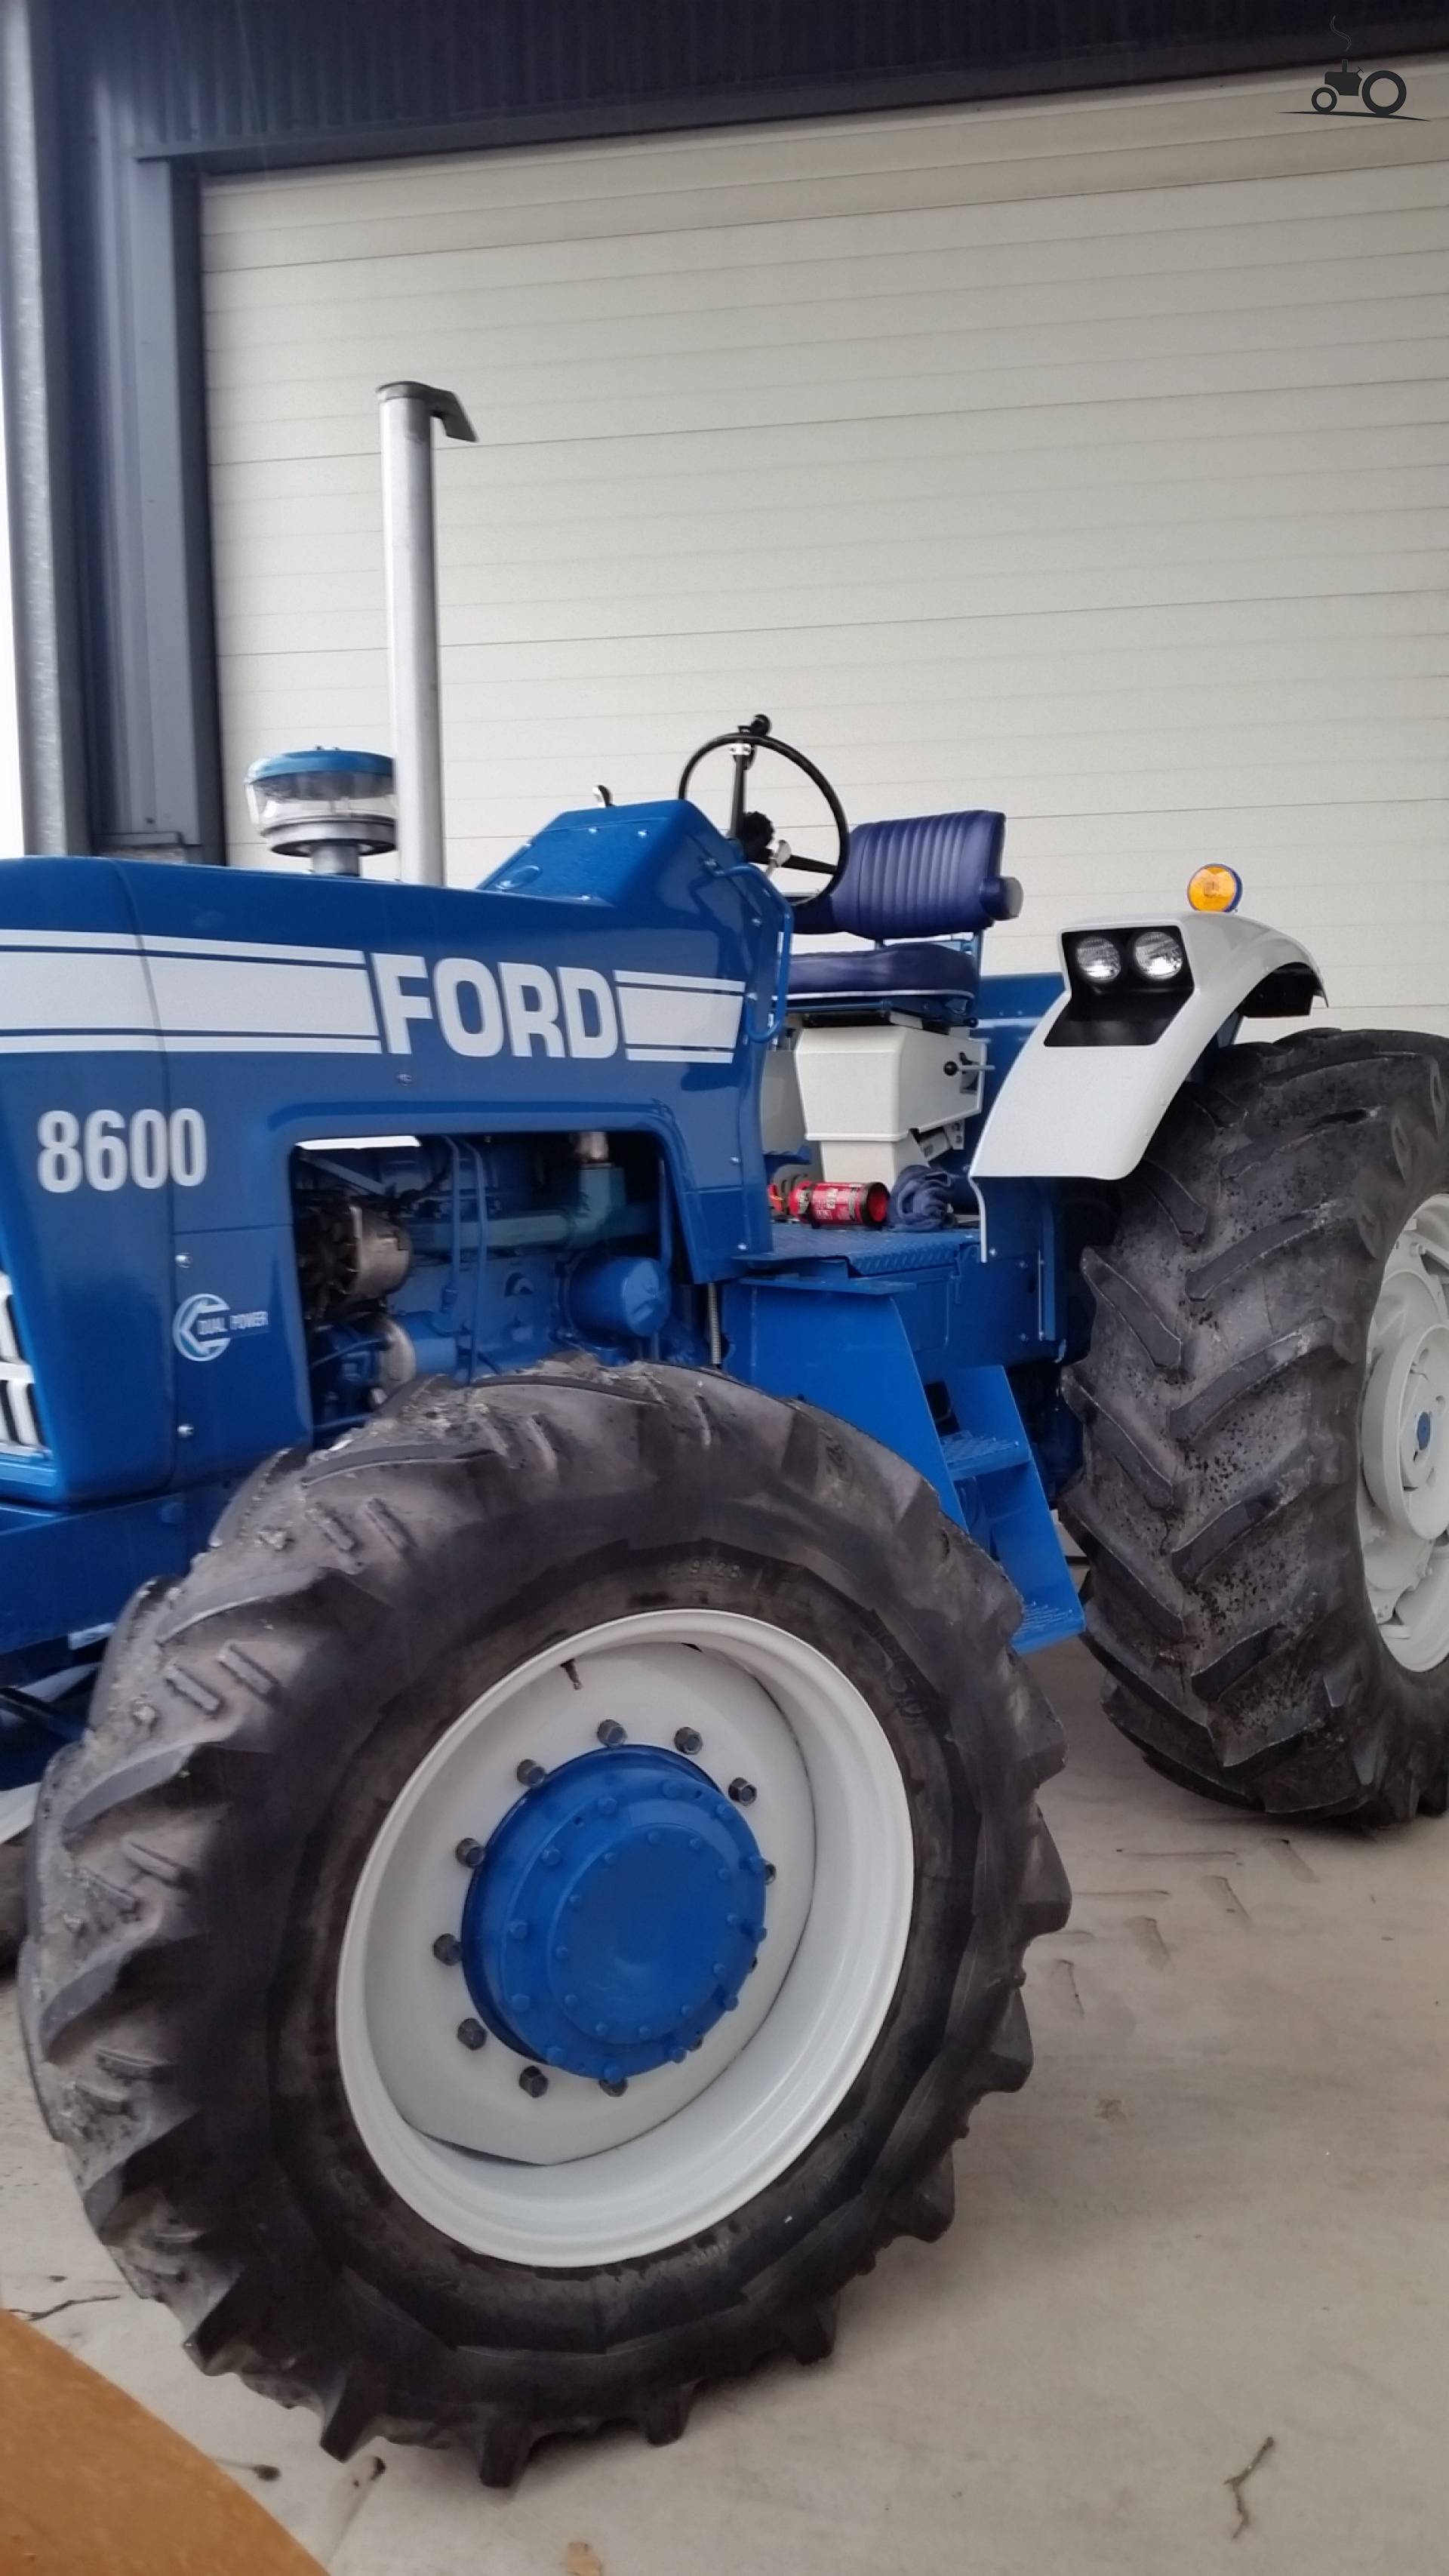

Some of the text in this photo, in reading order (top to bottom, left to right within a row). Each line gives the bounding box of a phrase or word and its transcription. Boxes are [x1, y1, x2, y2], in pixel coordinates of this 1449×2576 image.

[370, 953, 618, 1058] FORD
[38, 1107, 207, 1193] 8600
[197, 1311, 269, 1334] DUAL POWER
